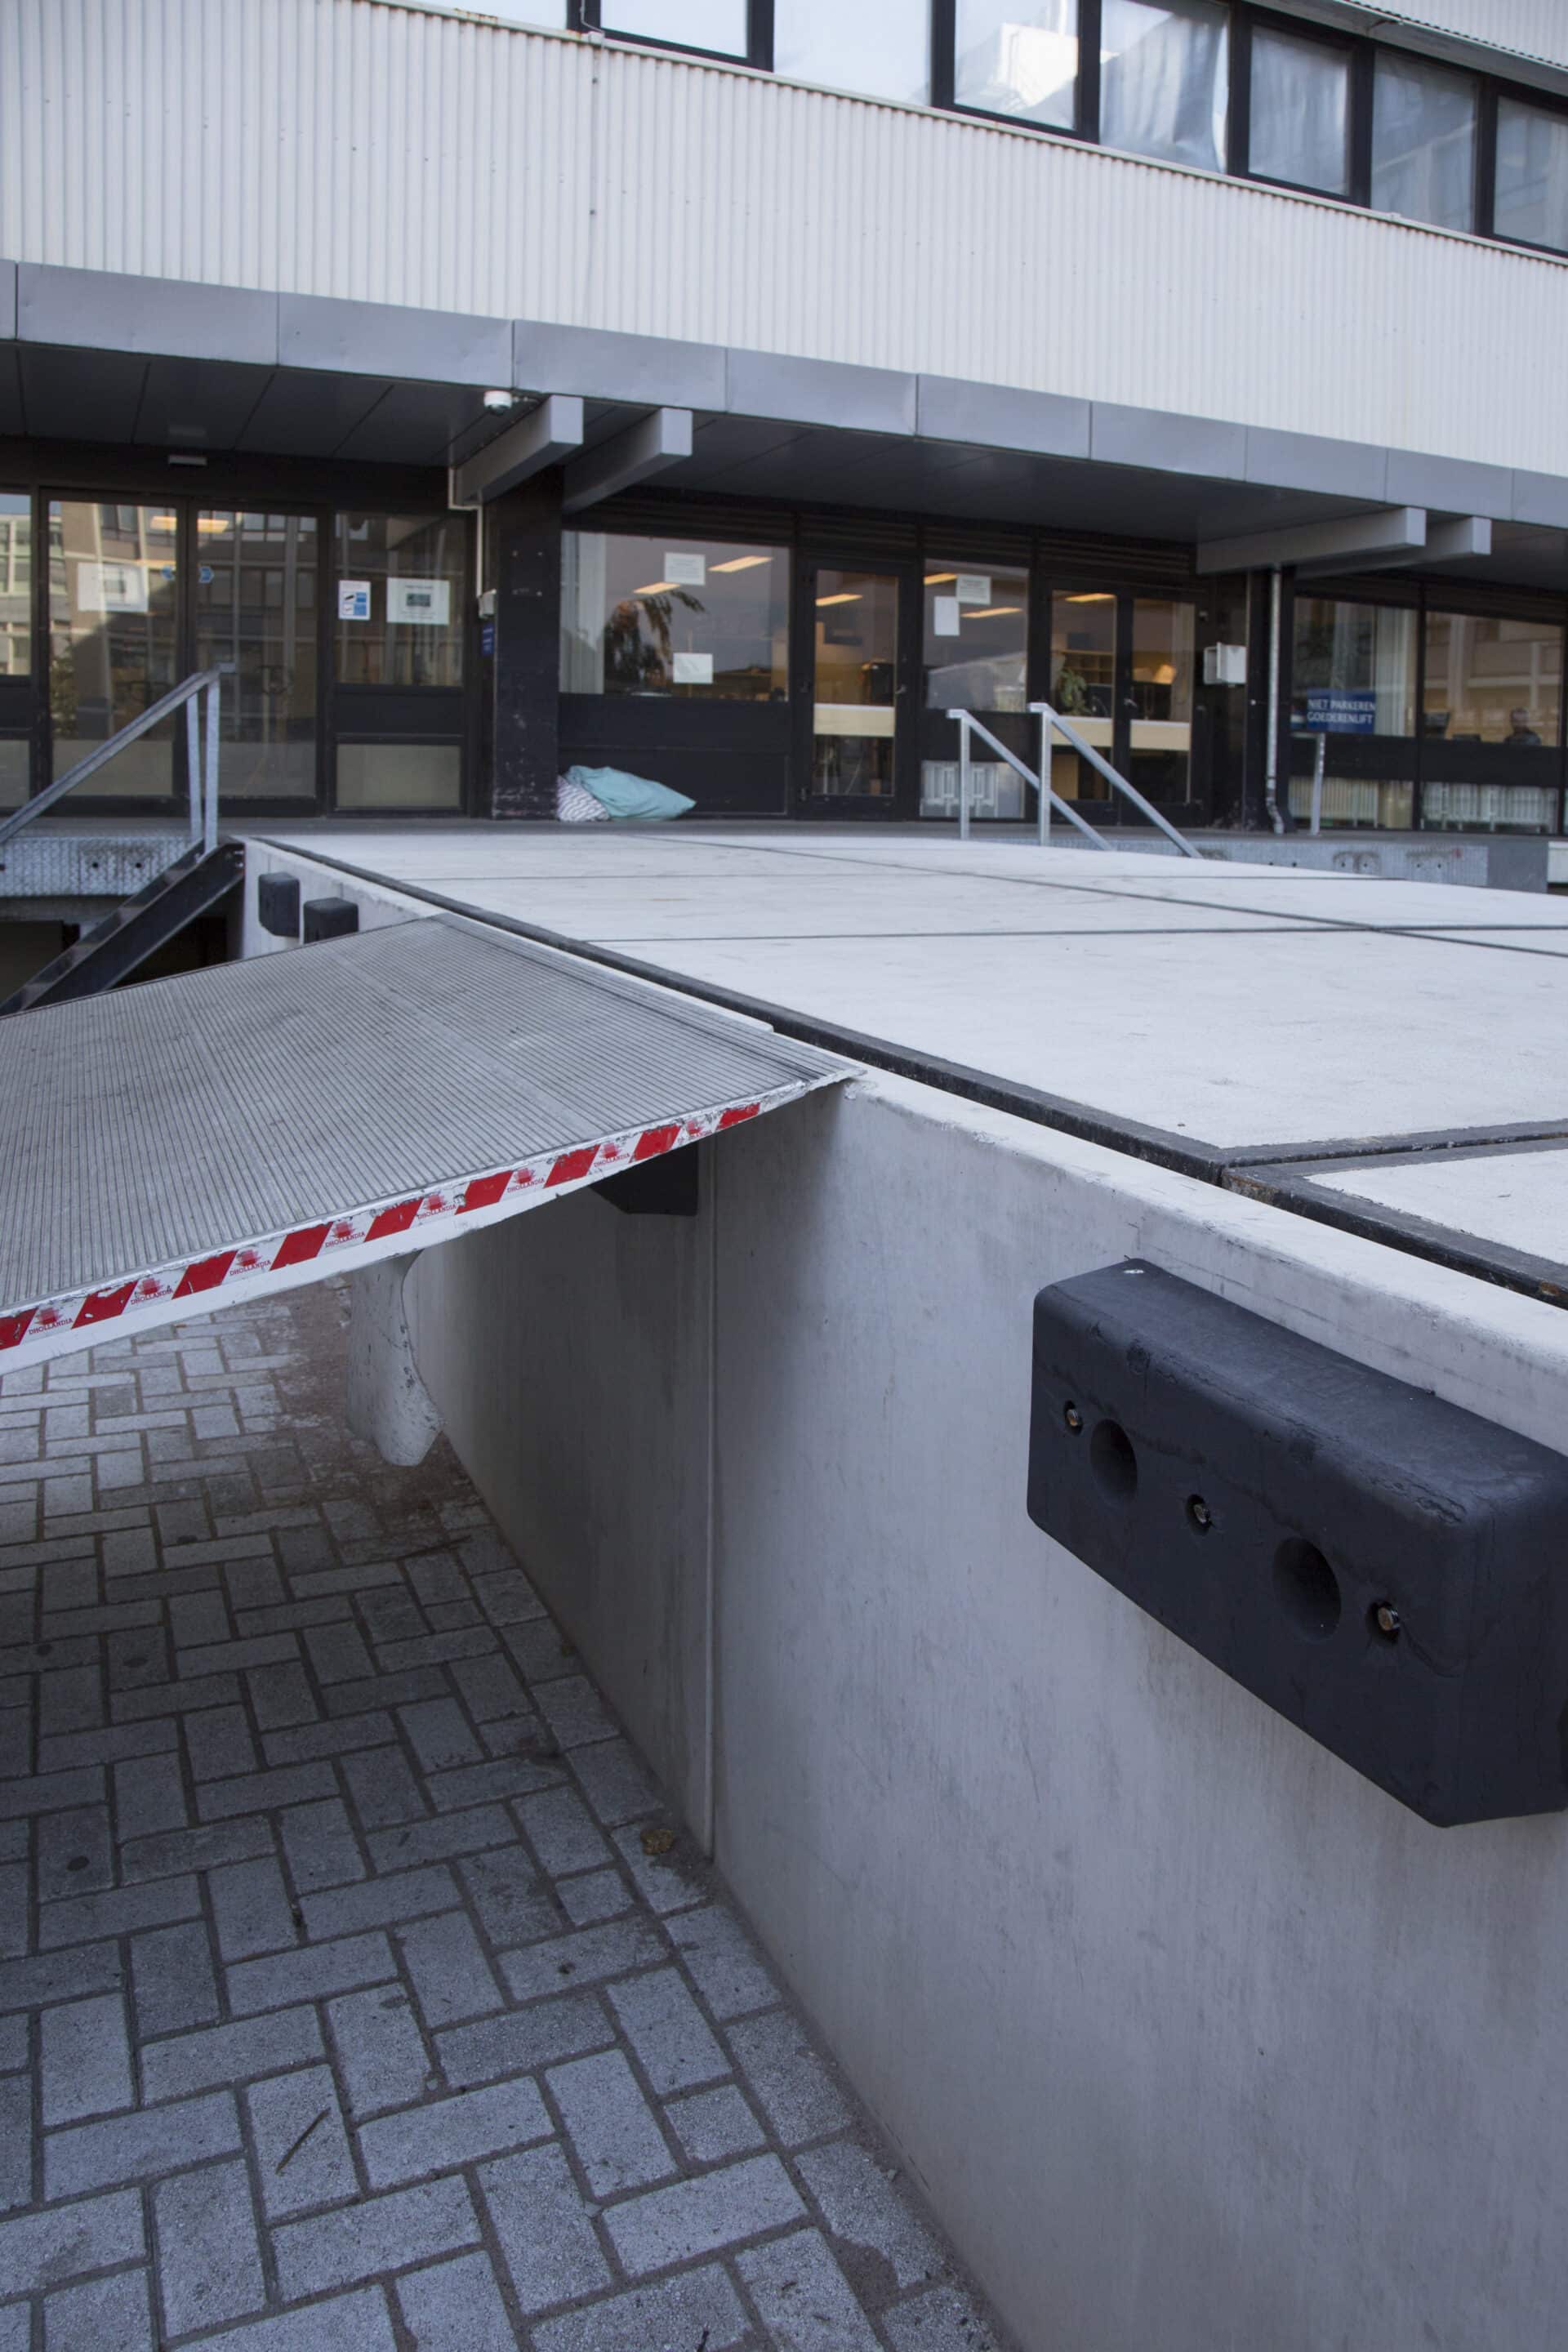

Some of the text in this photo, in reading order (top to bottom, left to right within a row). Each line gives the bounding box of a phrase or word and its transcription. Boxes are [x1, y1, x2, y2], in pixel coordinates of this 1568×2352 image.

[1307, 699, 1375, 711] NIET PARKEREN
[1307, 711, 1373, 724] GOEDERENLIFT
[594, 1152, 630, 1167] DHOLLANDIA
[507, 1178, 545, 1193] DHOLLANDIA
[416, 1204, 457, 1219] DHOLLANDIA
[325, 1232, 365, 1247] DHOLLANDIA
[229, 1259, 271, 1276] DHOLLANDIA
[131, 1288, 173, 1305] DHOLLANDIA
[29, 1318, 73, 1334] DHOLLANDIA
